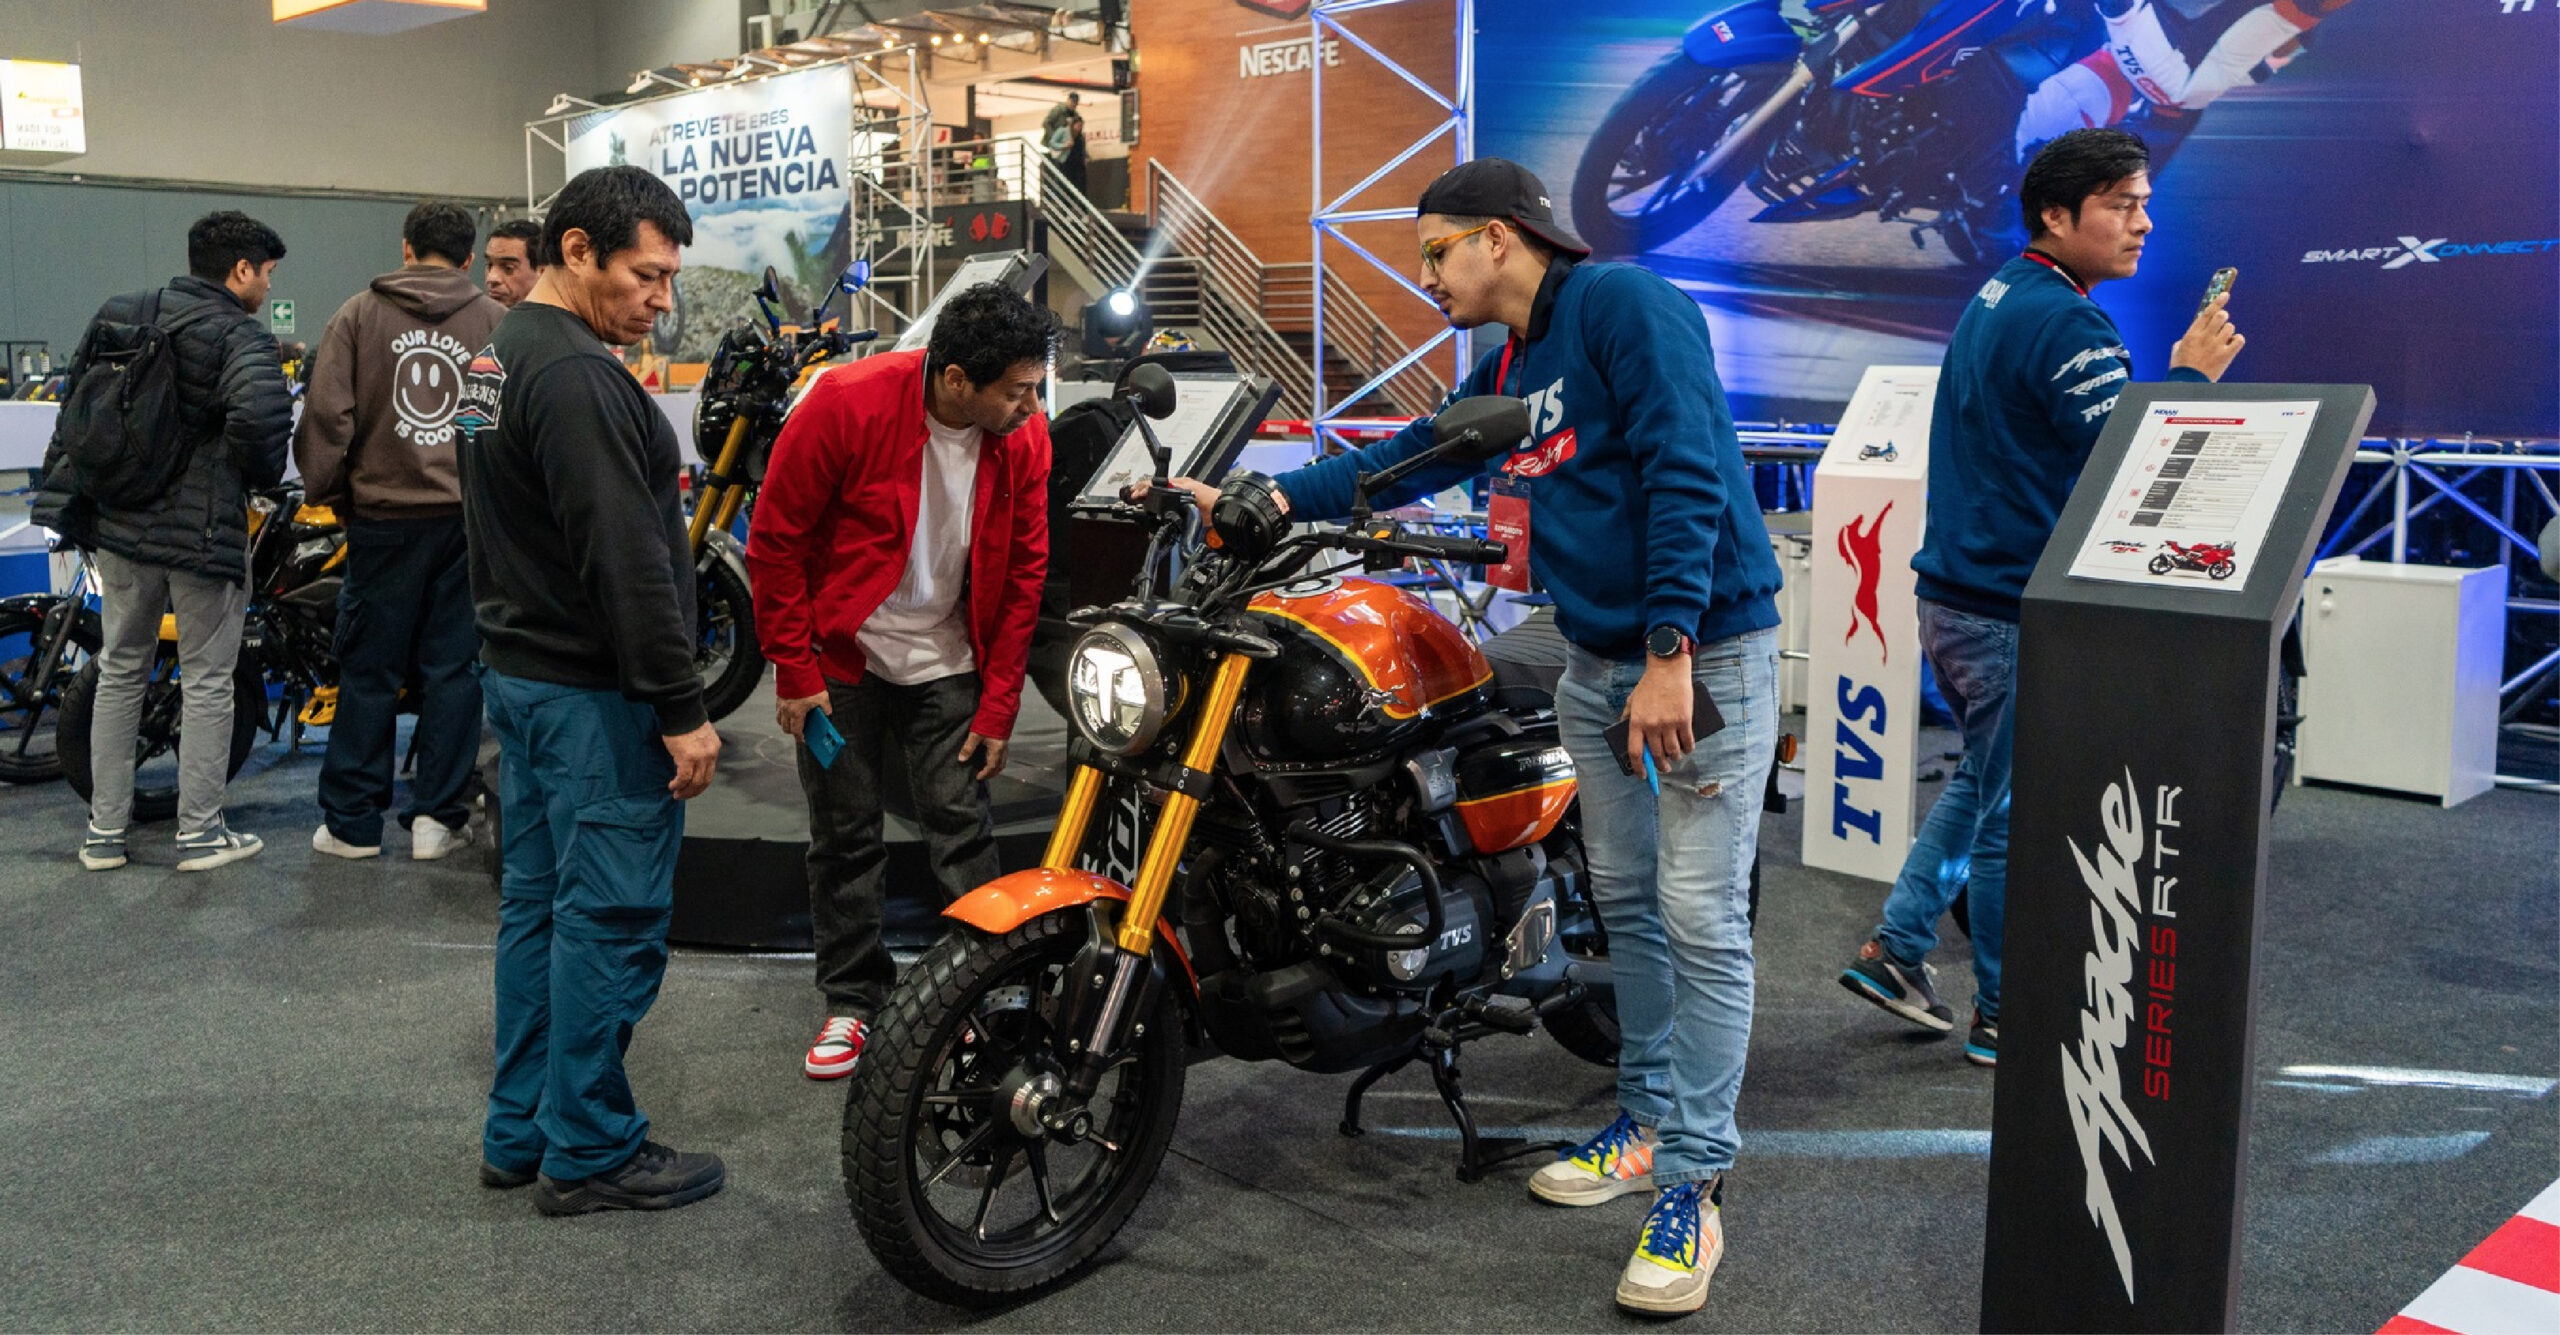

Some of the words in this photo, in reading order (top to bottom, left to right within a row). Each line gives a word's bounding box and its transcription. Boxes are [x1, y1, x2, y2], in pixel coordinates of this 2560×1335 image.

[2116, 45, 2144, 76] TVS
[750, 108, 789, 130] ERES
[662, 144, 698, 176] LA
[711, 124, 817, 169] NUEVA
[680, 158, 839, 204] POTENCIA
[391, 329, 428, 354] OUR
[430, 331, 472, 365] LOVE
[395, 419, 412, 438] IS
[1520, 377, 1563, 449] VS
[1833, 674, 1887, 846] TVS
[2152, 784, 2183, 919] RTR
[1440, 923, 1472, 950] TVS
[2061, 765, 2156, 1305] Apache
[2144, 926, 2177, 1101] SERIES
